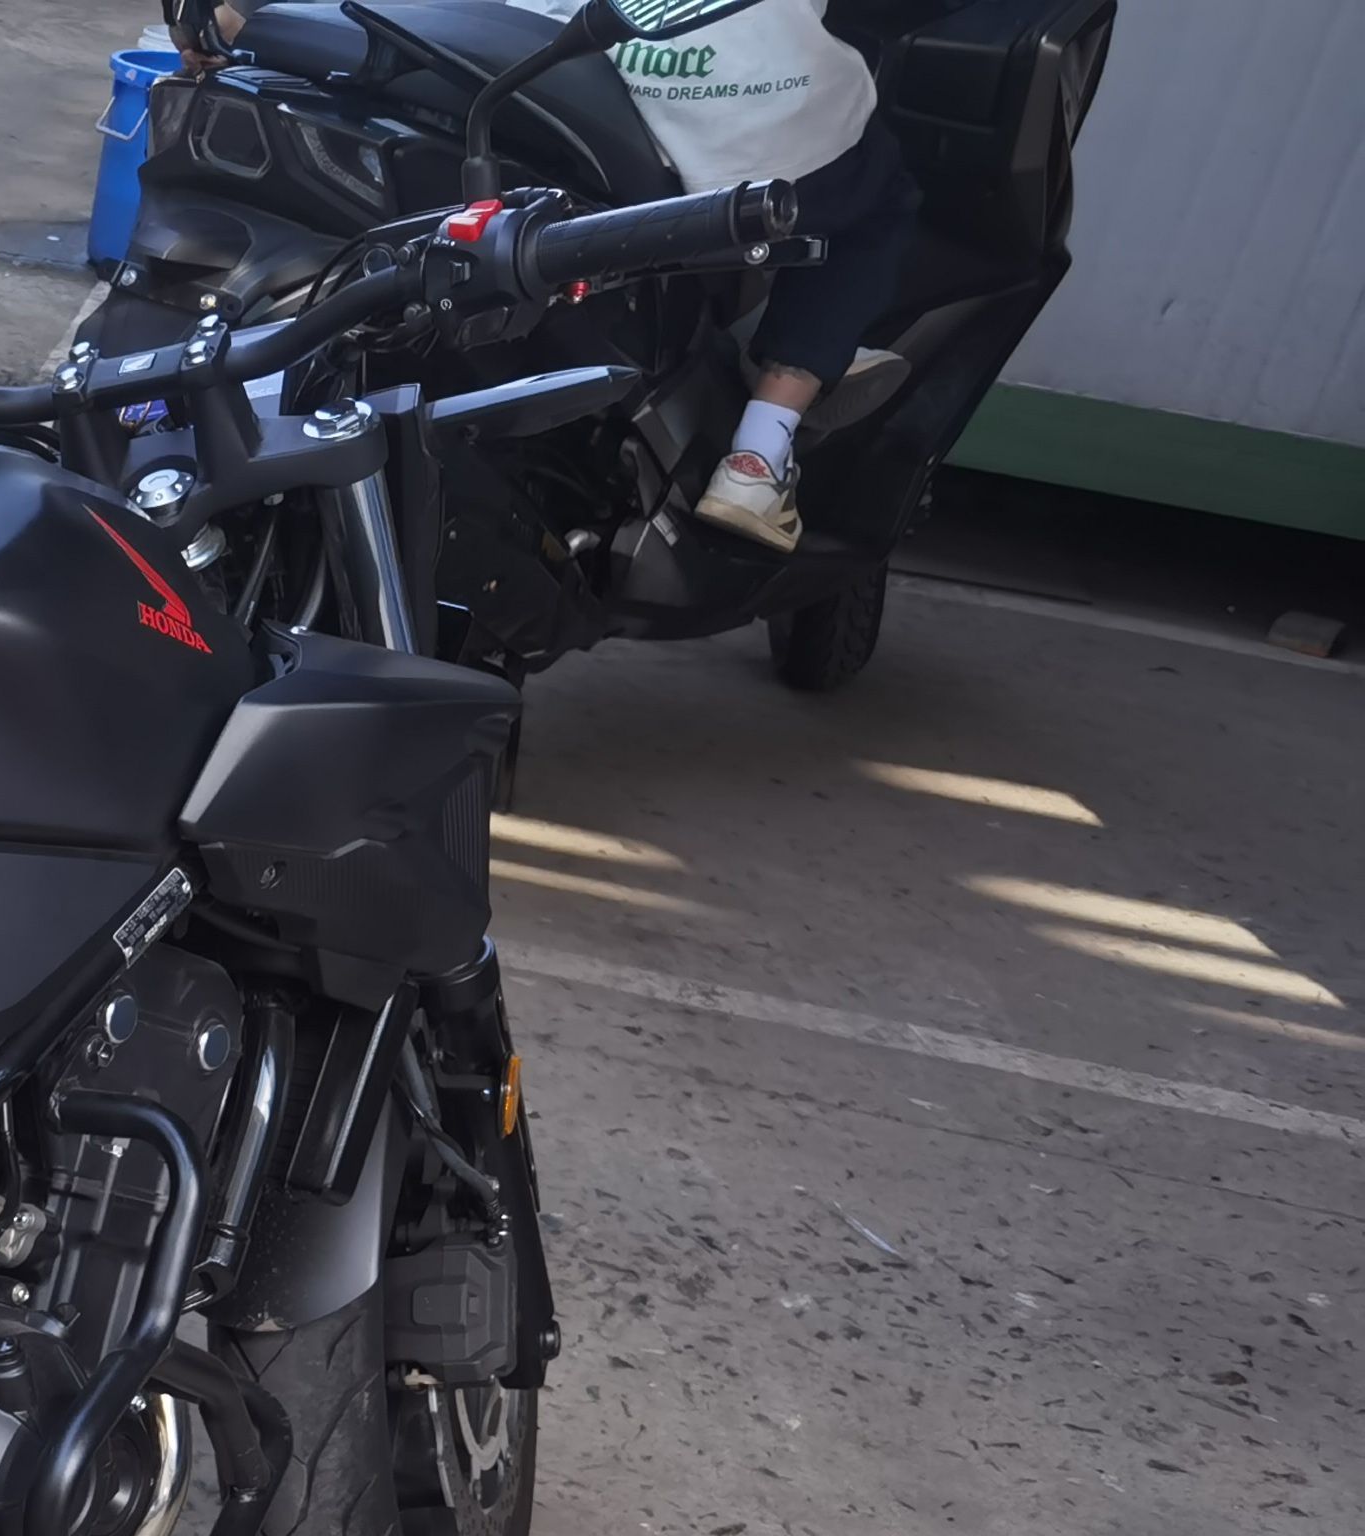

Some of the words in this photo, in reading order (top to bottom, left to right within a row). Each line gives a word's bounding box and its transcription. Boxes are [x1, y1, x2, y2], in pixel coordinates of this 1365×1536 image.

[667, 83, 739, 100] DREAMS
[742, 82, 772, 96] AND
[776, 75, 811, 91] LOVE
[137, 600, 213, 654] HONDA
